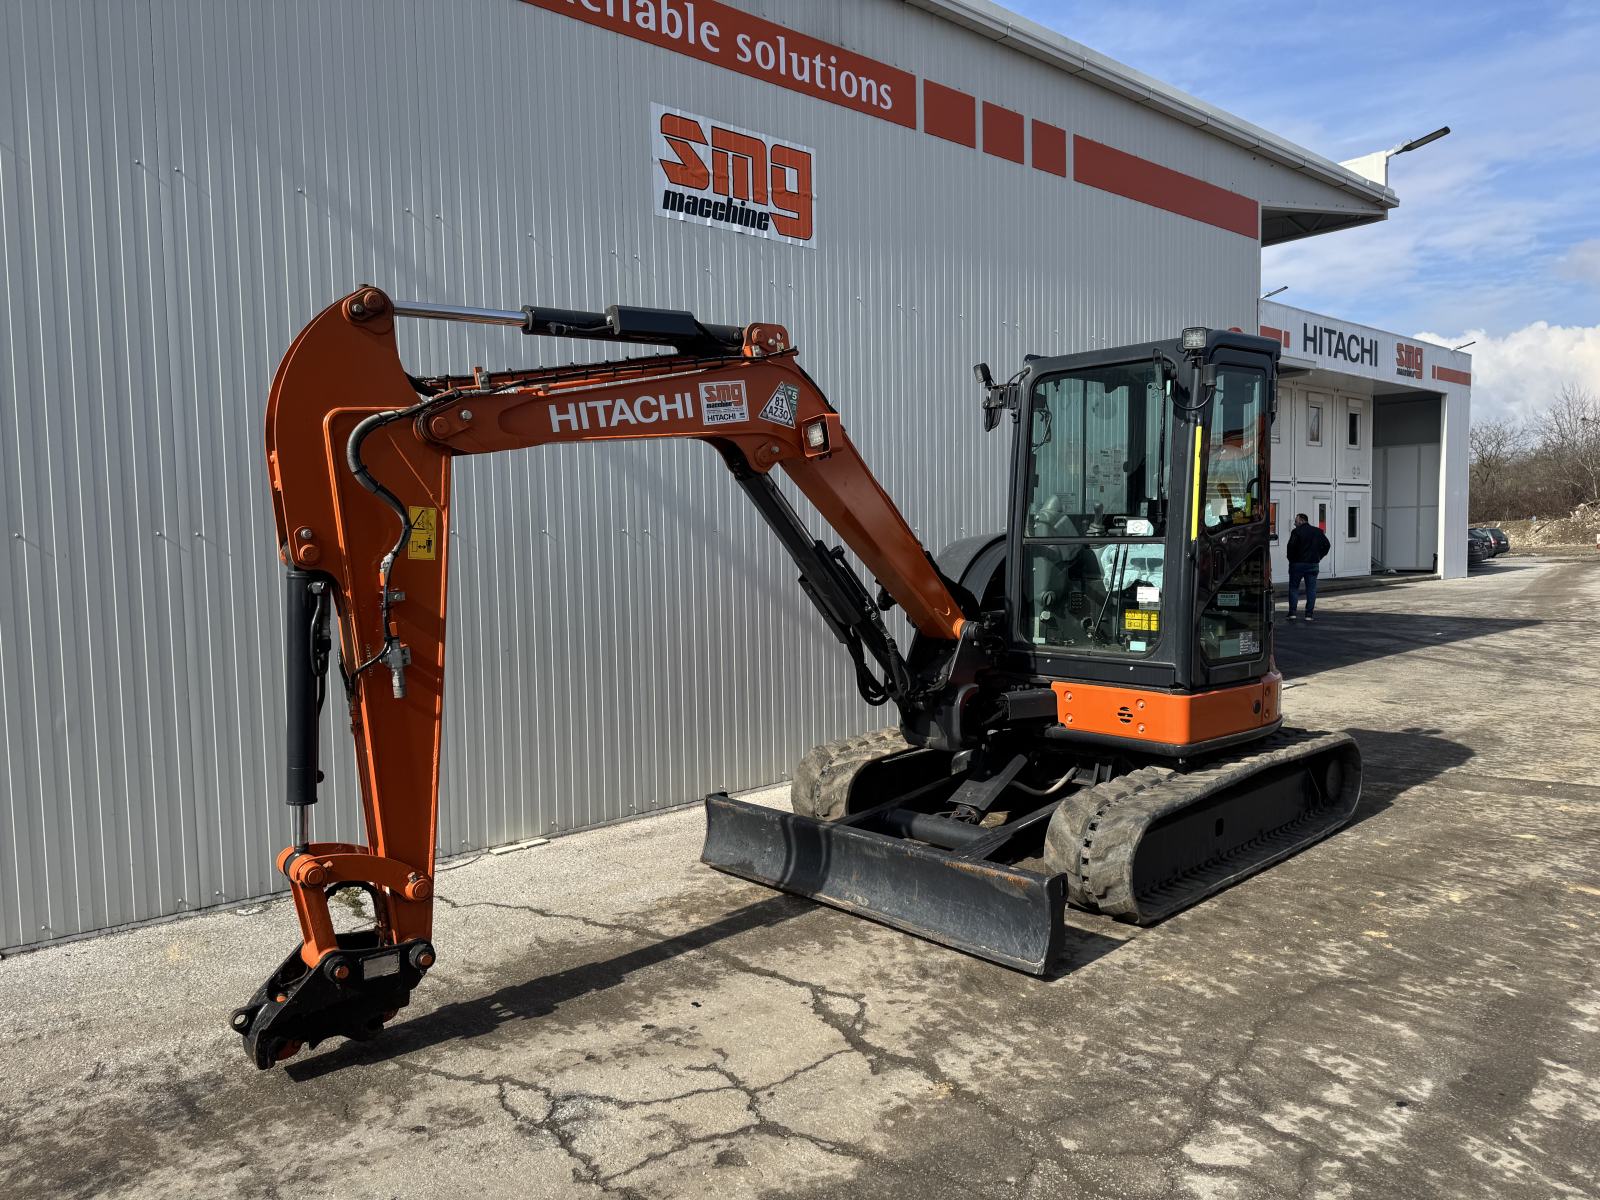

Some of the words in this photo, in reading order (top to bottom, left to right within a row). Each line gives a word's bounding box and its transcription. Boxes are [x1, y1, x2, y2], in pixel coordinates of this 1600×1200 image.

[736, 33, 893, 111] solutions
[659, 112, 812, 241] smg
[662, 189, 770, 231] macchine
[1303, 323, 1377, 366] HITACHI
[548, 393, 694, 432] HITACHI
[707, 413, 736, 422] HITACHI
[775, 396, 784, 408] 81
